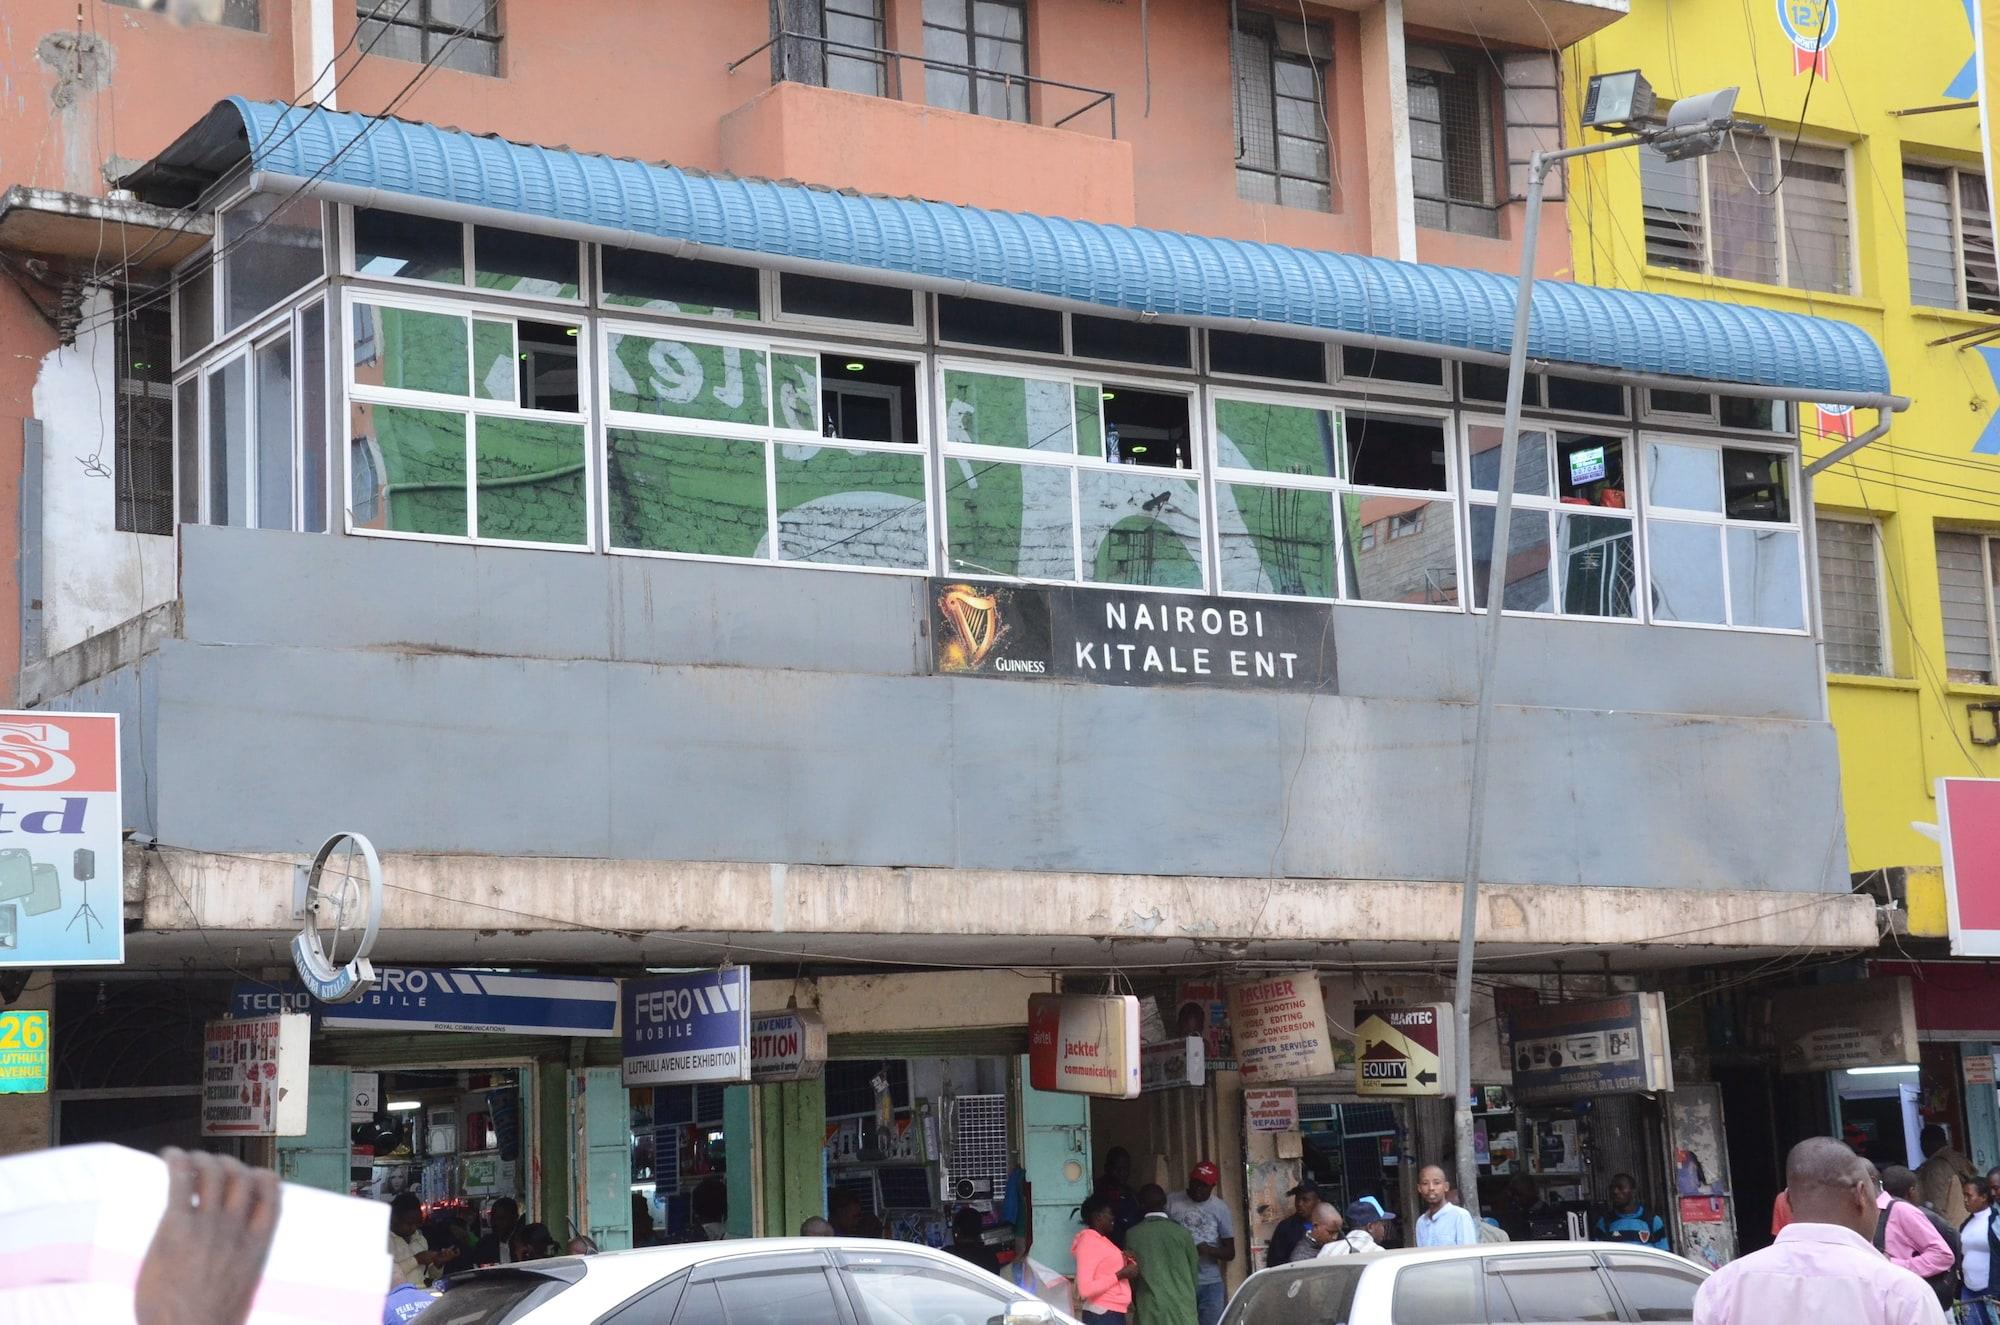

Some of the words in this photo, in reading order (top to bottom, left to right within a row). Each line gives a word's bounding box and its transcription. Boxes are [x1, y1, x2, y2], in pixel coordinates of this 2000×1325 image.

[1106, 602, 1263, 638] NAIROBI
[995, 656, 1045, 674] GUINNESS
[1075, 641, 1212, 674] KITALE
[1231, 650, 1298, 679] ENT
[365, 968, 429, 993] ERO
[356, 994, 427, 1007] OBILE
[635, 988, 692, 1025] FERO
[1264, 1000, 1306, 1014] SHOOTING
[757, 1017, 793, 1032] AVENUE
[1270, 1012, 1303, 1024] EDITING
[1390, 1011, 1433, 1025] MARTEC
[0, 1016, 43, 1048] 26
[636, 1023, 692, 1041] MOBILE
[1263, 1021, 1315, 1036] CONVERSION
[752, 1032, 797, 1060] BITION
[1243, 1045, 1277, 1058] COMPUTER
[1280, 1039, 1318, 1052] SERVICES
[0, 1053, 43, 1063] UTHULI
[629, 1059, 660, 1075] LUTHULI
[661, 1056, 690, 1073] AVENUE
[692, 1052, 736, 1069] EXHIBITION
[1064, 1064, 1117, 1078] communication
[1363, 1062, 1406, 1077] EQUITY
